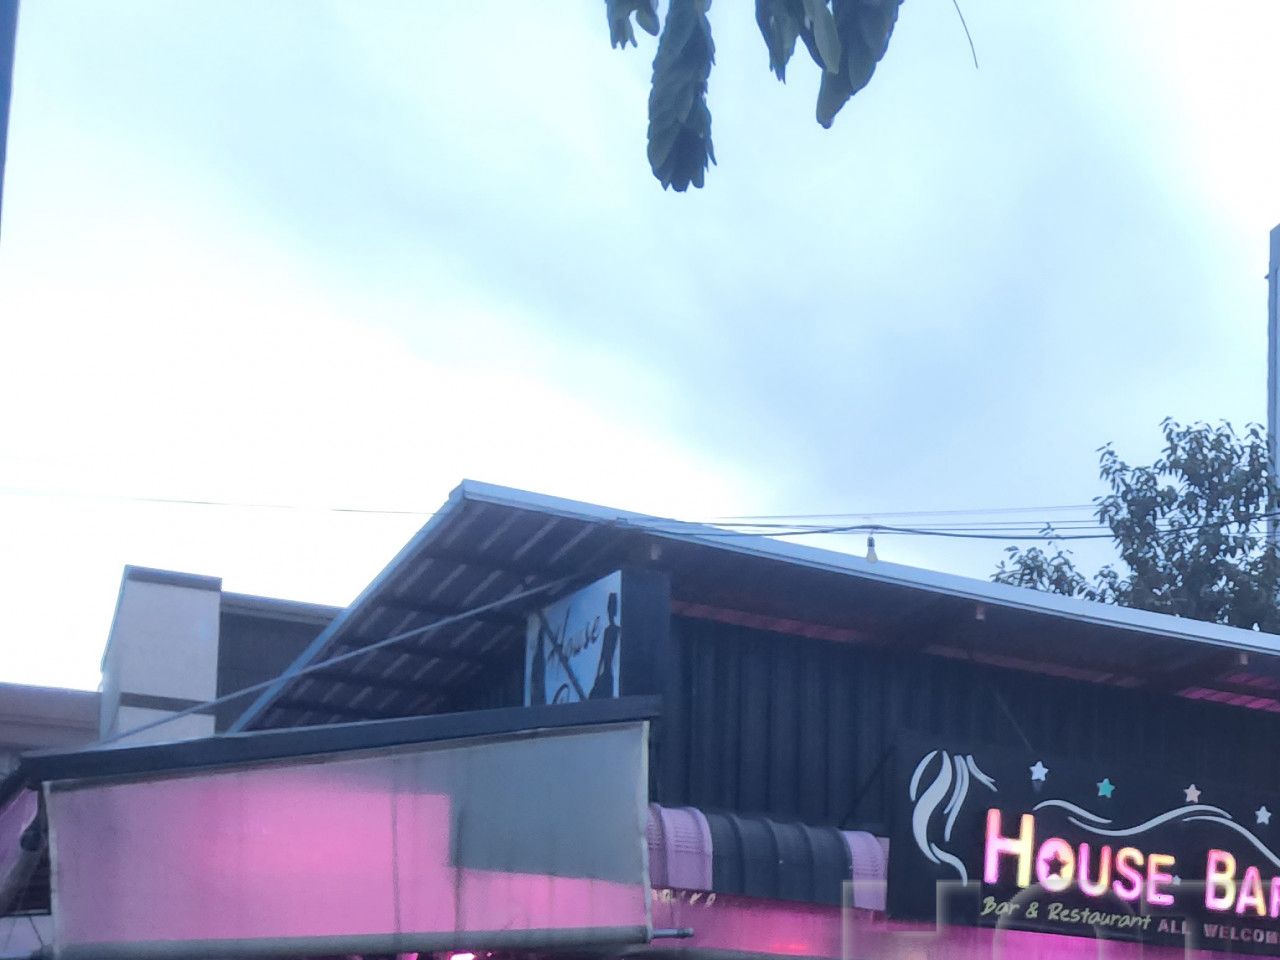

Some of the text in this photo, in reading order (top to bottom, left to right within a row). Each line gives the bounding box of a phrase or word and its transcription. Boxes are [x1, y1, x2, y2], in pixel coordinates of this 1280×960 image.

[982, 808, 1176, 906] HOUSE
[980, 896, 1152, 930] Bar & Restaurant
[1157, 918, 1192, 936] ALL
